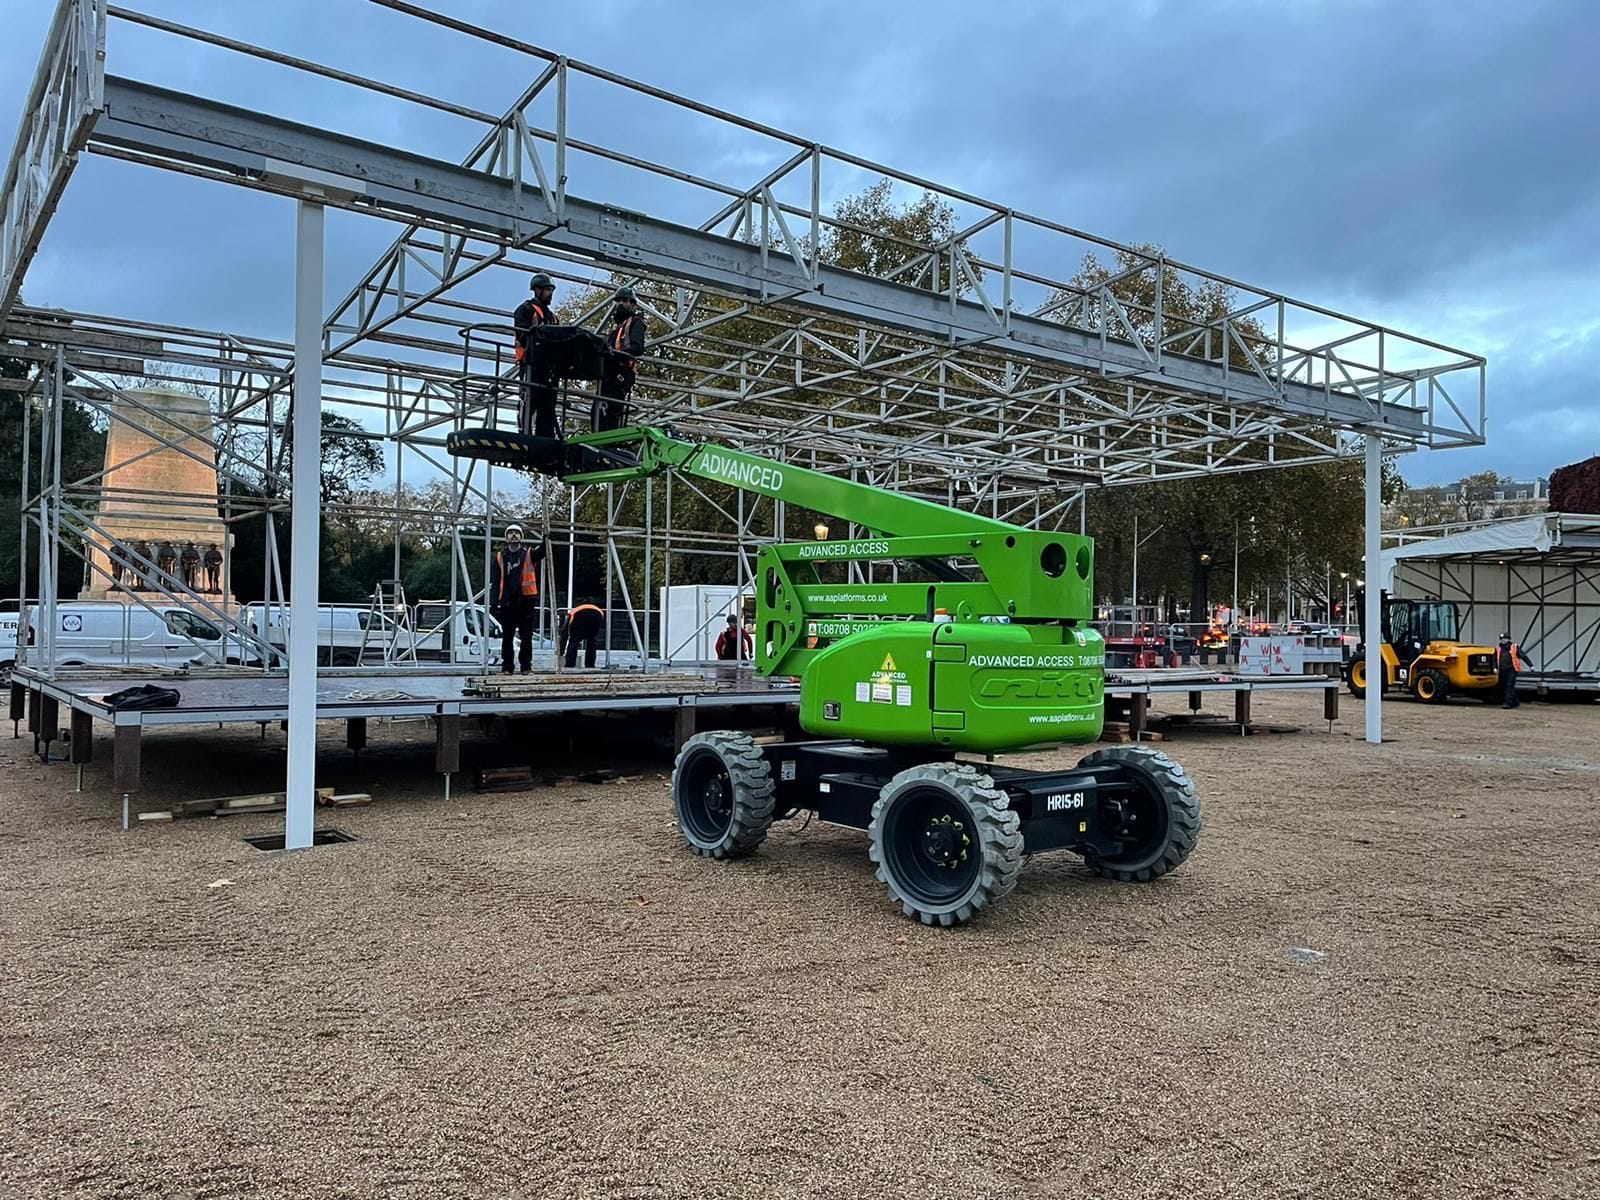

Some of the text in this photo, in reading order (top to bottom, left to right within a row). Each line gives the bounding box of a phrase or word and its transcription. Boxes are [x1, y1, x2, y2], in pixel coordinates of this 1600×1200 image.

[700, 453, 783, 491] ADVANCED
[799, 541, 889, 557] ADVANCED ACCESS
[807, 593, 888, 604] www.aaplatforms.co.uk
[817, 623, 850, 635] T:08708
[968, 655, 1035, 667] ADVANCED
[1036, 655, 1075, 667] ACCESS
